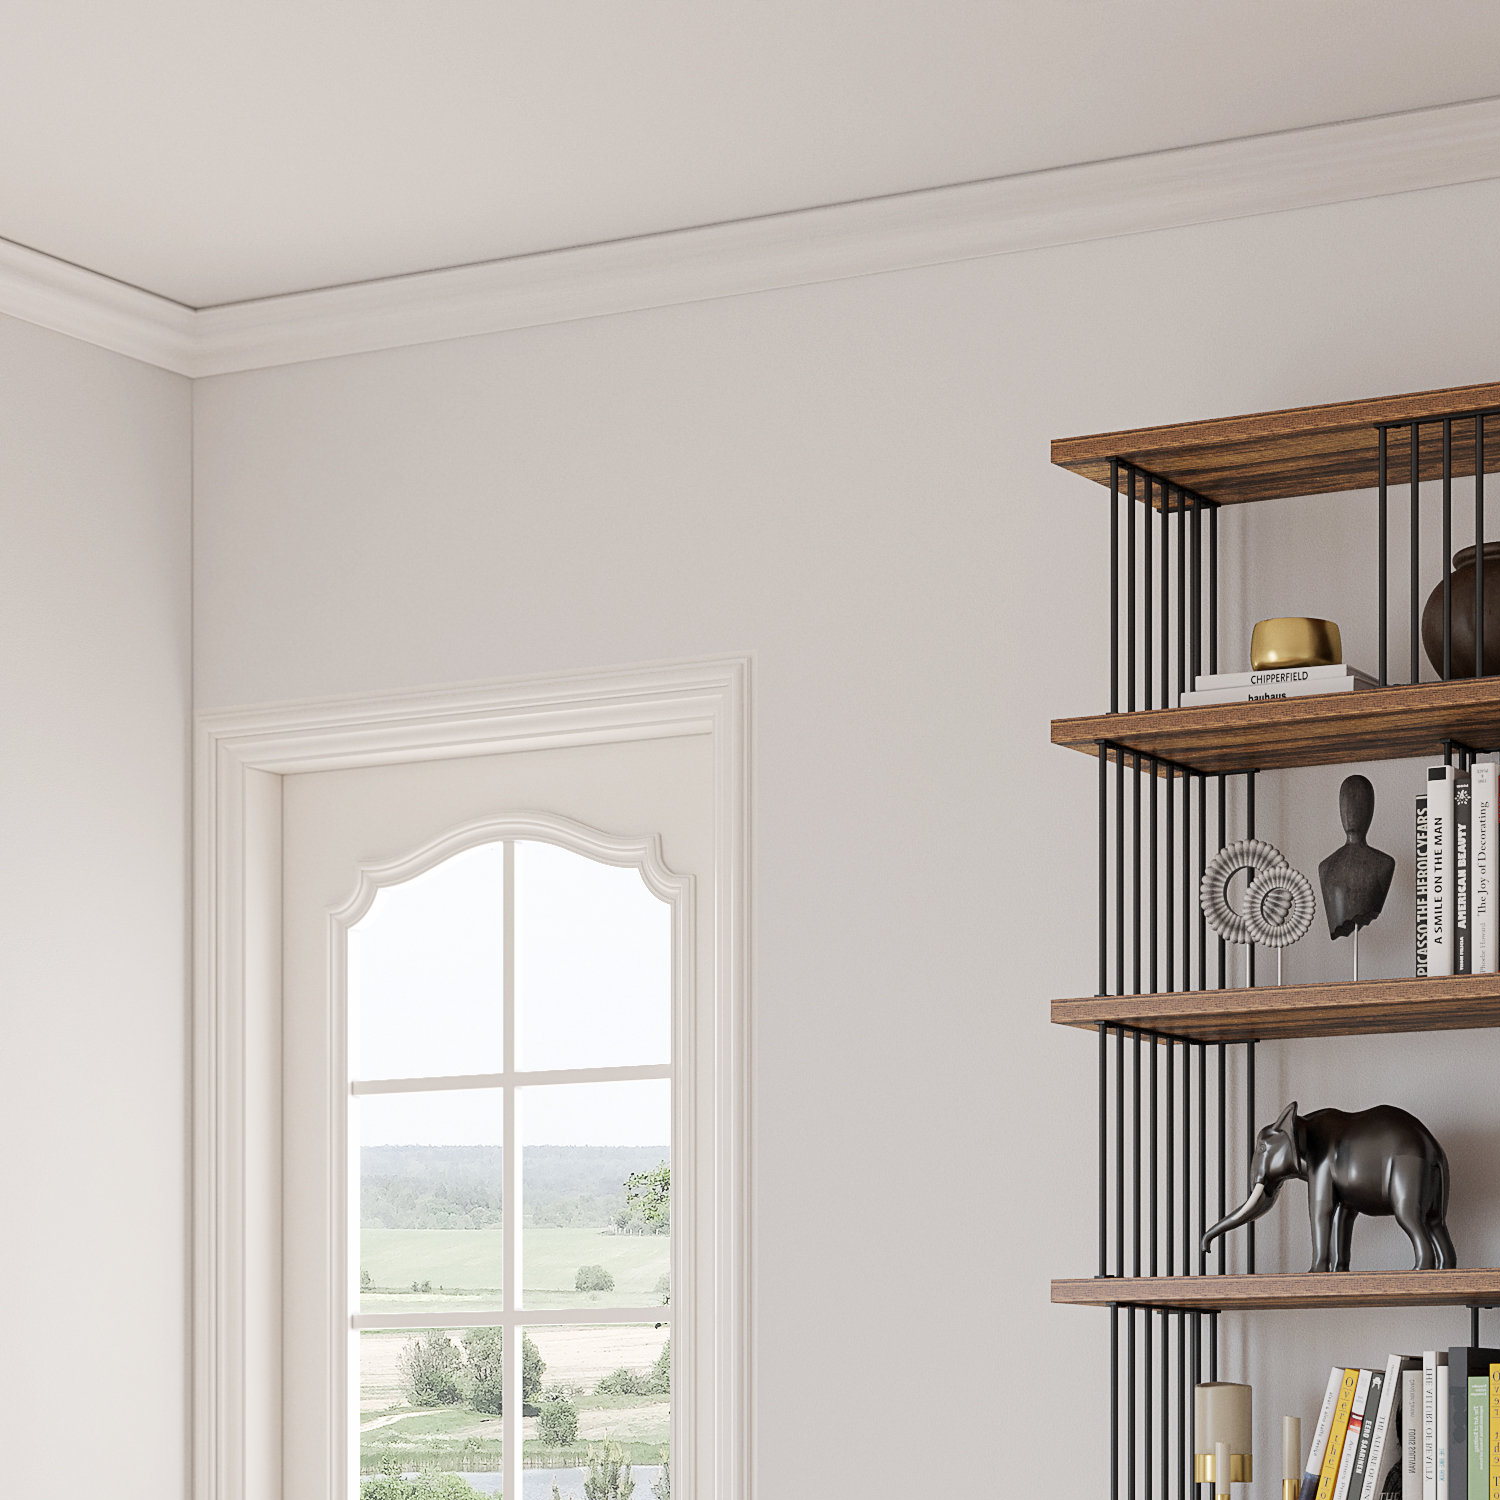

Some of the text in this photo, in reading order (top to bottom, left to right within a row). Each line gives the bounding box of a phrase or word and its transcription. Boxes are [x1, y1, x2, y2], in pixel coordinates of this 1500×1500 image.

[1251, 671, 1308, 685] CHIPPERFIELD
[1417, 807, 1428, 976] PICASSO THE HEROIC YEARS
[1434, 816, 1443, 944] A SMILE ON THE MAN
[1457, 823, 1467, 929] AMERICAN BEAUTY
[1477, 801, 1489, 916] The Joy of Decorating
[1363, 1420, 1373, 1443] EERO
